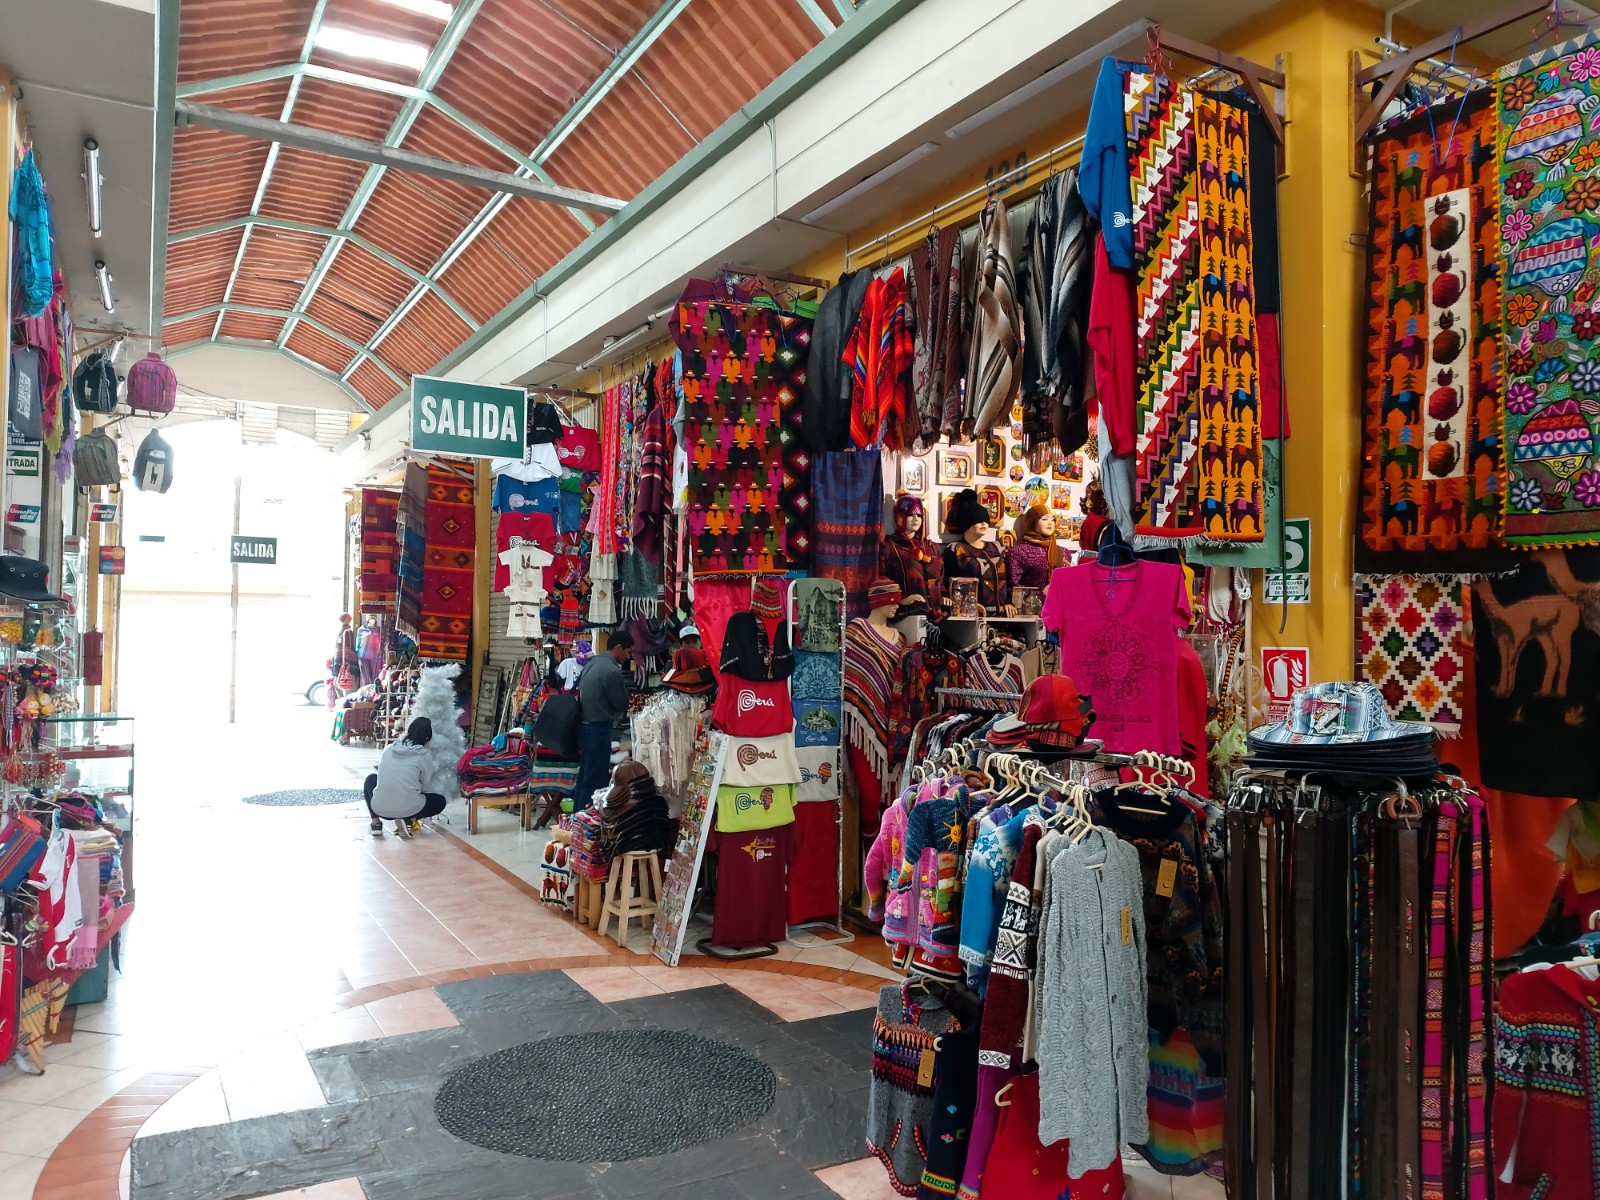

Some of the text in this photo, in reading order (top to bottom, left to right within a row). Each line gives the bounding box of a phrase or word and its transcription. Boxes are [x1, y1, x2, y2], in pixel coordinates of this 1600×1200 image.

[420, 395, 518, 443] SALIDA
[6, 458, 36, 468] TRADA
[233, 541, 274, 558] SALIDA
[737, 689, 775, 718] Perú
[737, 743, 777, 772] Perú
